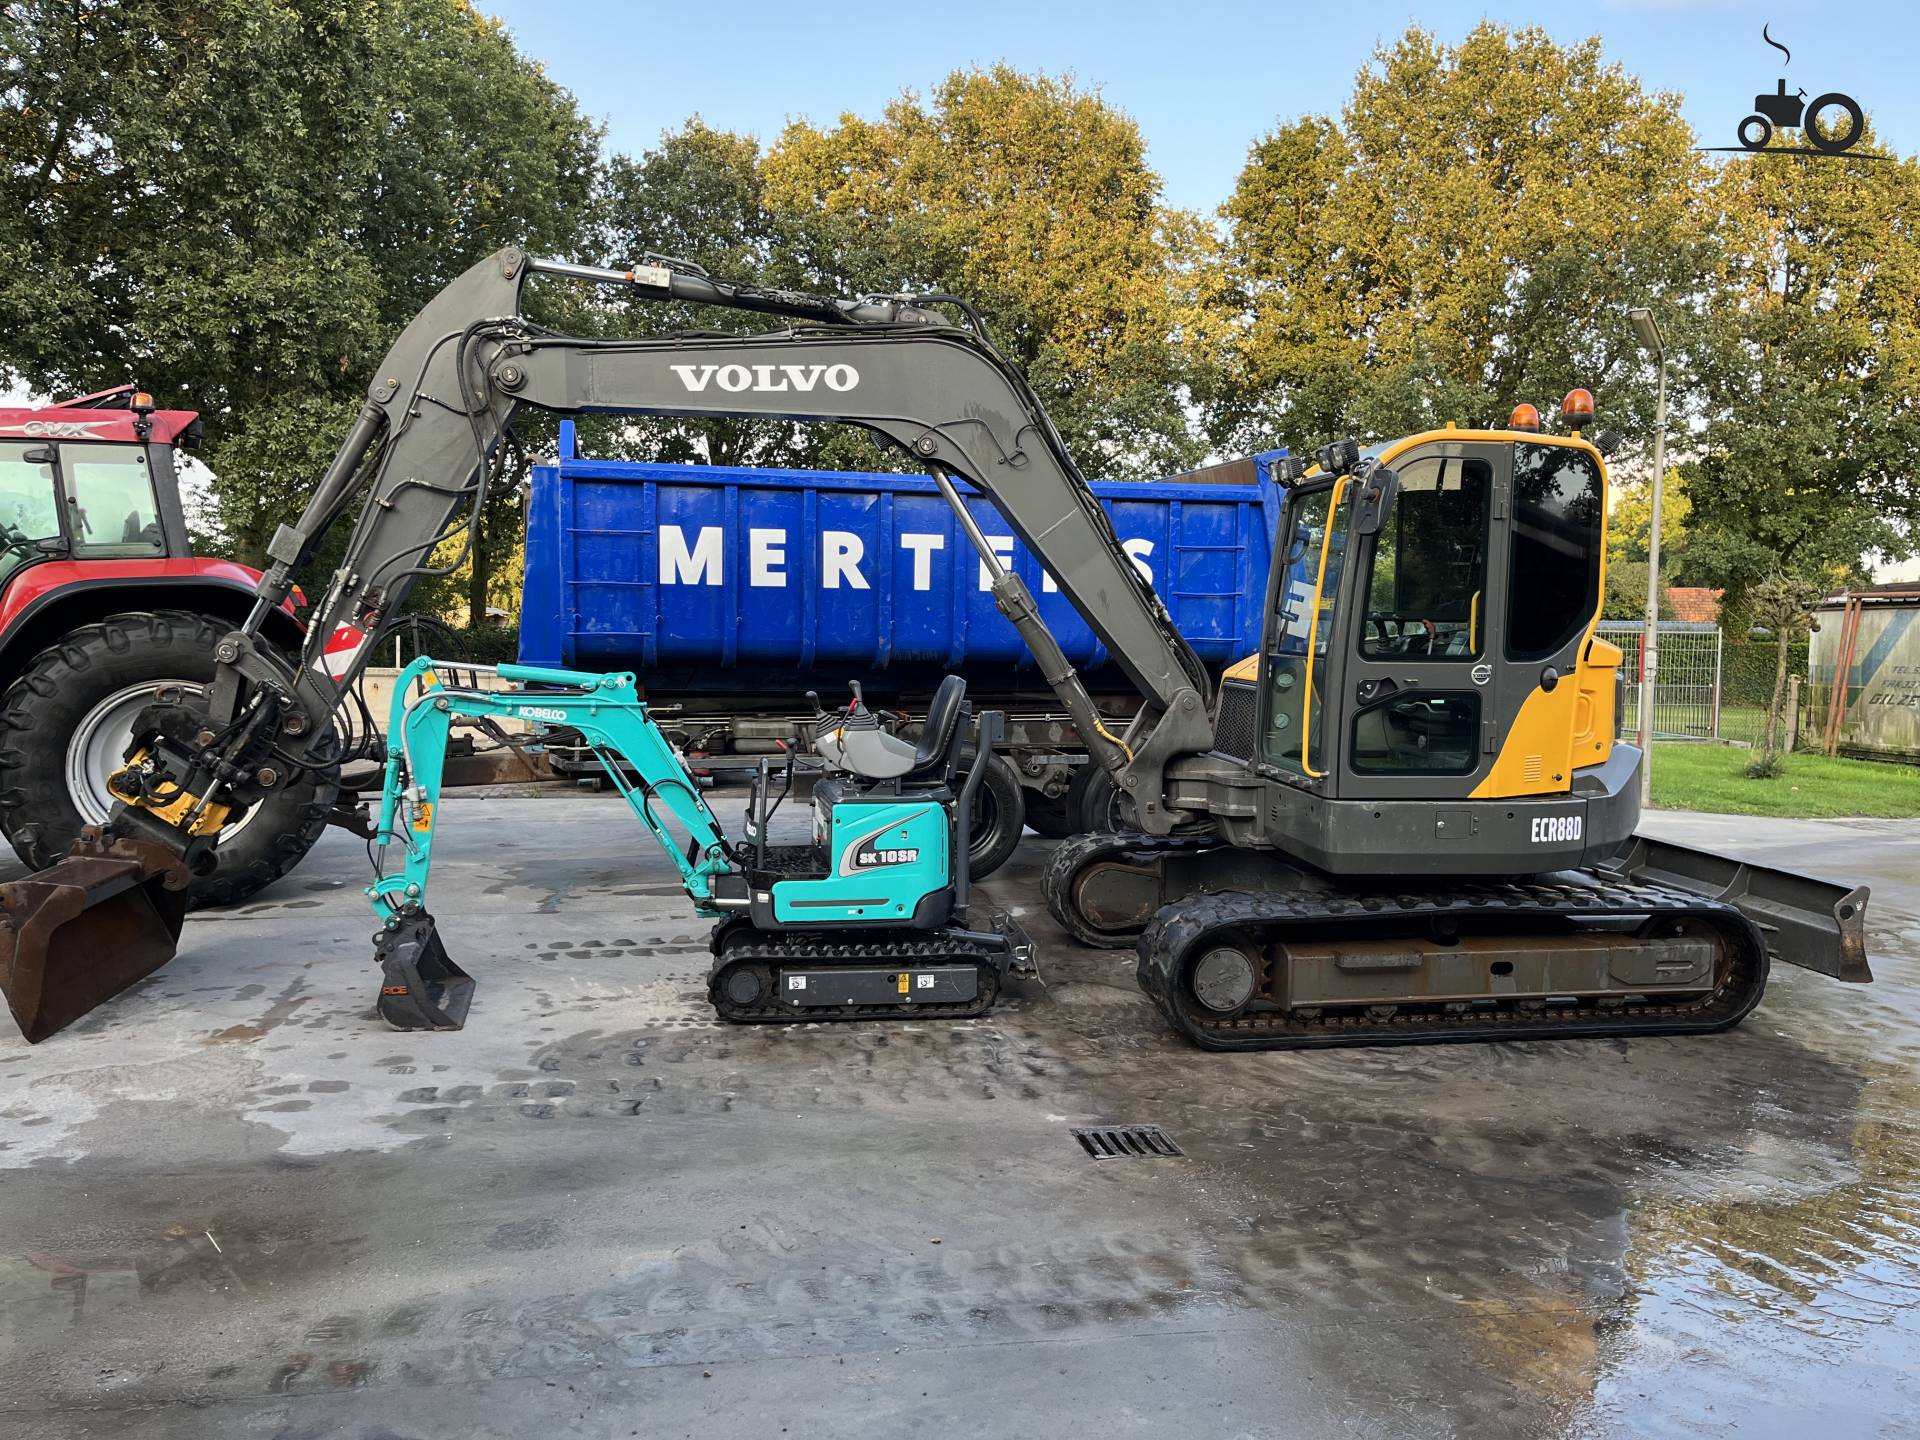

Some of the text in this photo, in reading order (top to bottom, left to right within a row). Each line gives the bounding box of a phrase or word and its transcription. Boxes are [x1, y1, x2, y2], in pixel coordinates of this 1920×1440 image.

[669, 364, 860, 392] VOLVO
[659, 525, 1155, 592] MERTES
[518, 705, 567, 721] KOBELCO
[1531, 816, 1582, 842] ECR88D
[860, 849, 917, 864] SK 10SR
